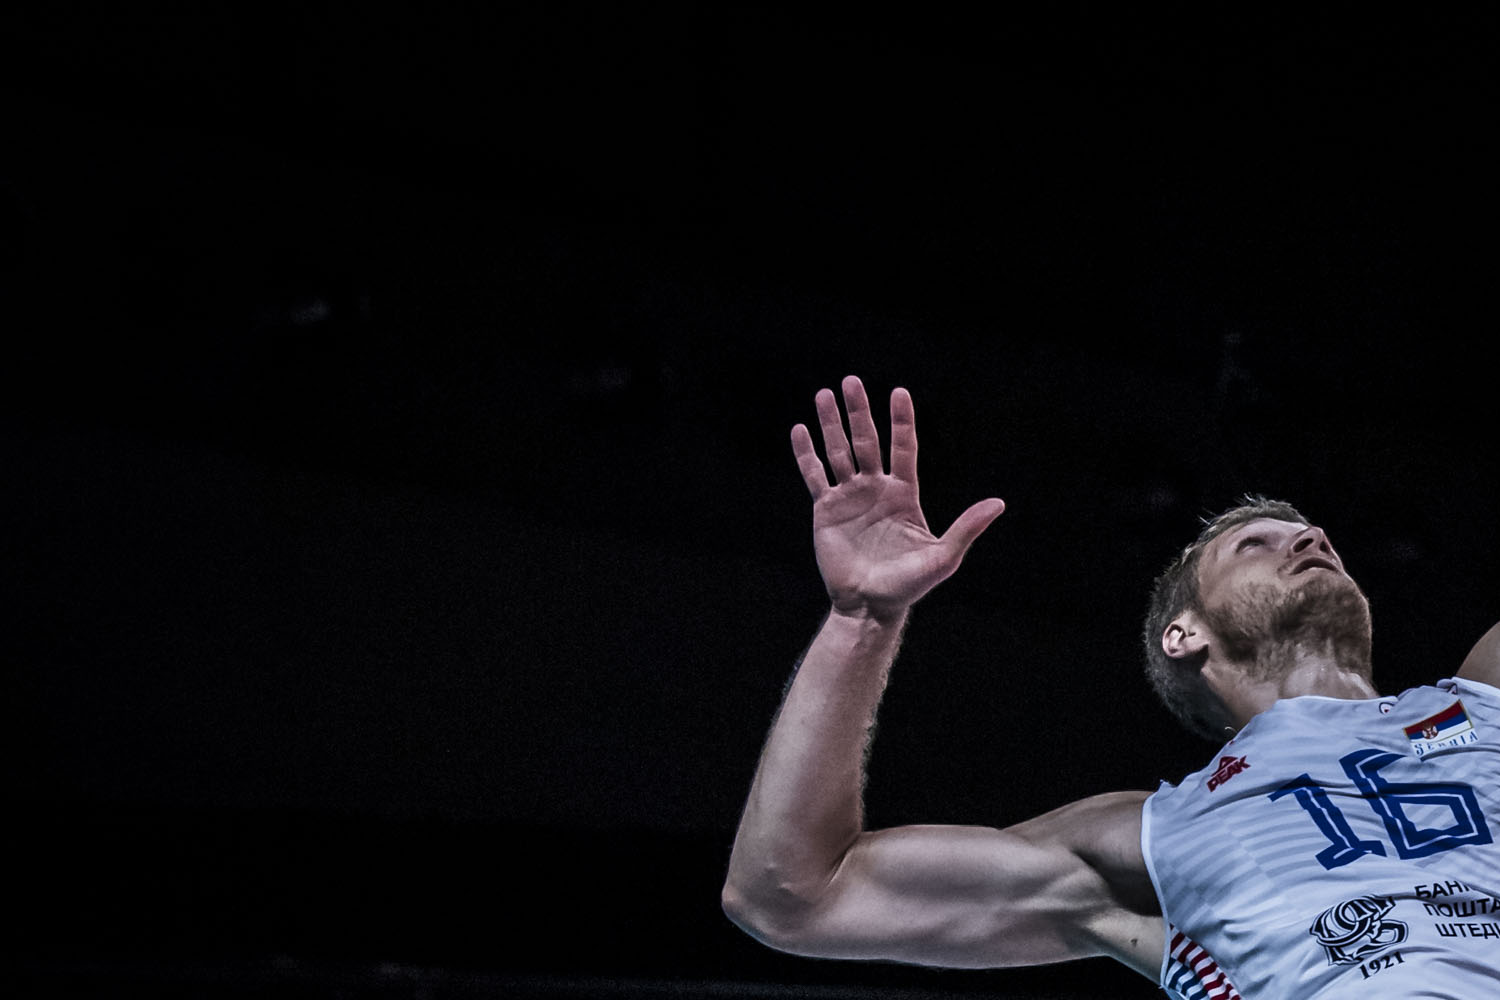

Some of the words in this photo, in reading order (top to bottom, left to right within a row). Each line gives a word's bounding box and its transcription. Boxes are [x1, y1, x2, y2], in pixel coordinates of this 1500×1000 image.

[1207, 755, 1251, 792] PEAK
[1267, 748, 1494, 871] 16
[1359, 951, 1405, 980] 1921
